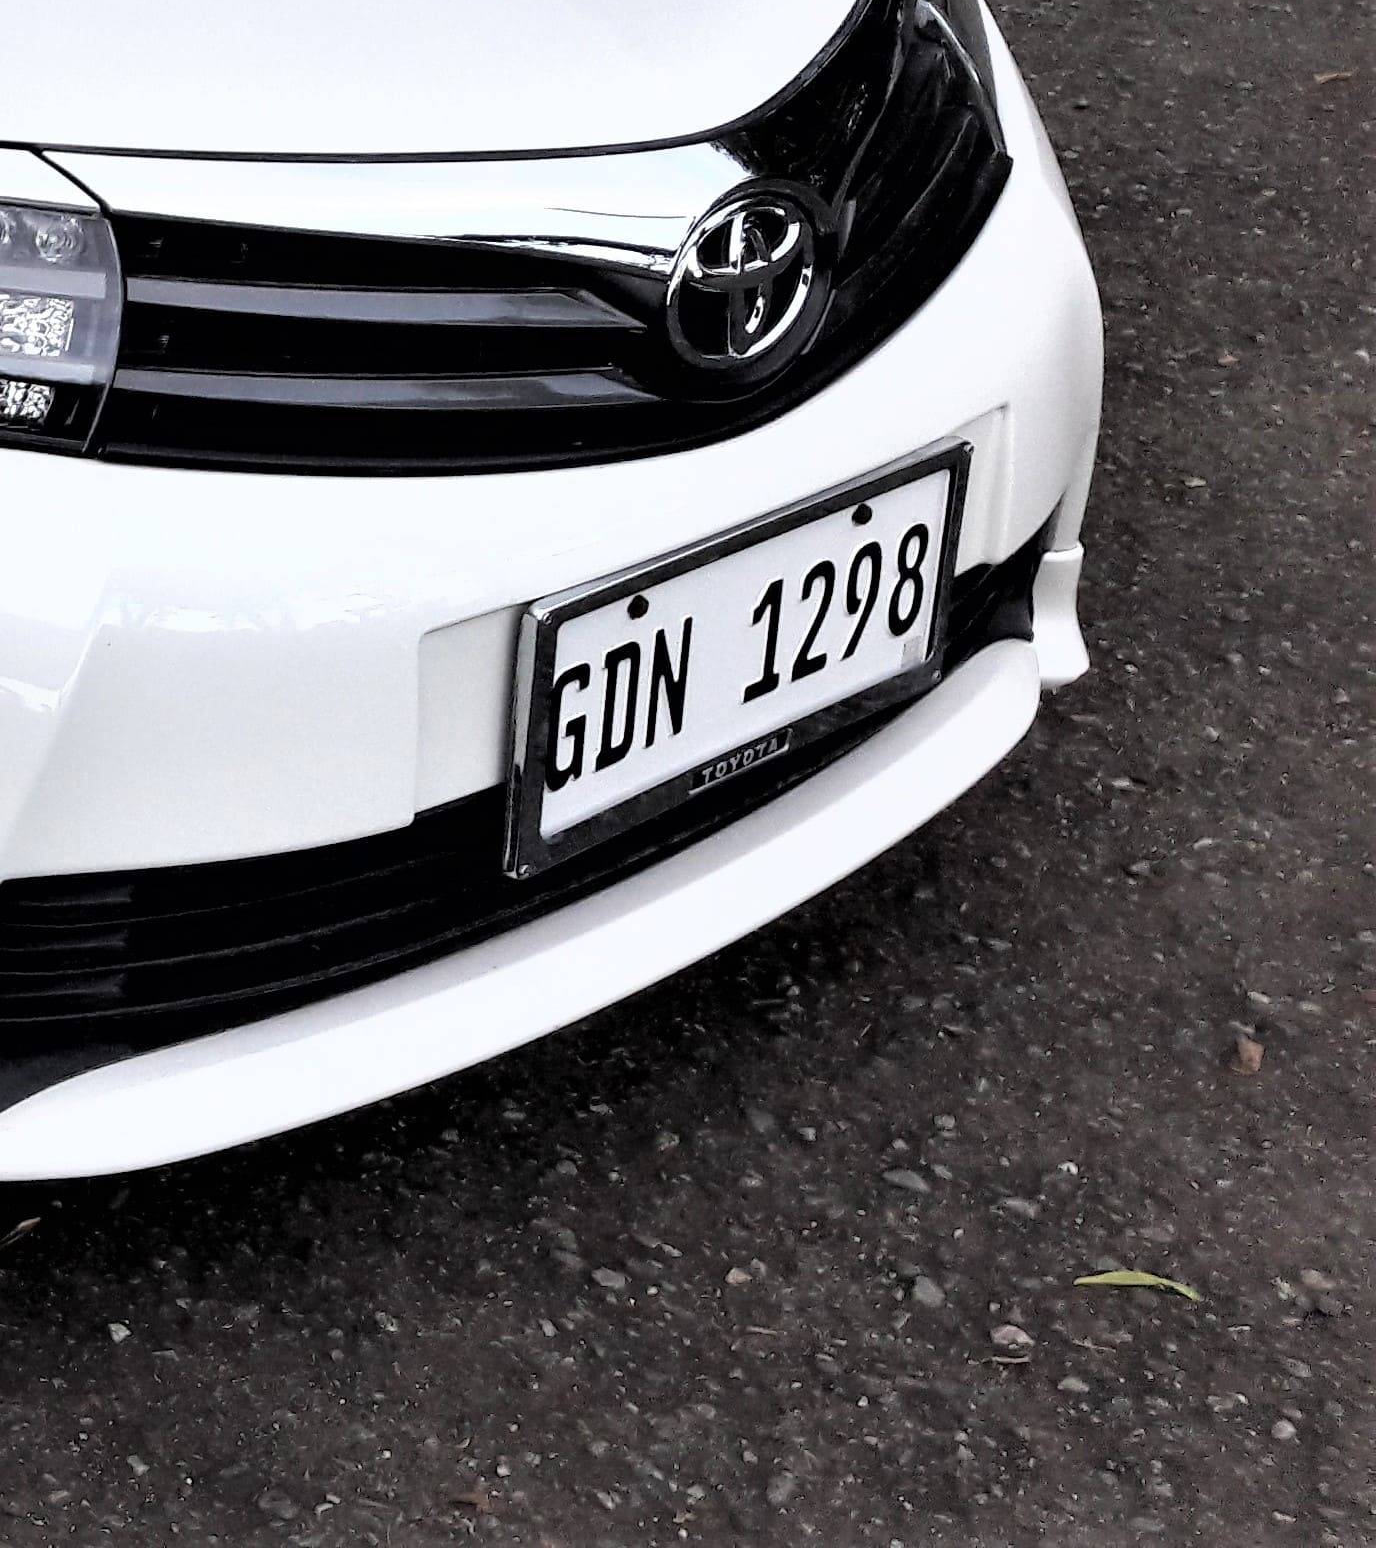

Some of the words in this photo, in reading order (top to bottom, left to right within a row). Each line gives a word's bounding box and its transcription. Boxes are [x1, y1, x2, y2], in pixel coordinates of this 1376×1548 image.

[546, 617, 693, 792] GDN
[743, 523, 929, 704] 1298
[701, 738, 778, 784] TOYOTA
